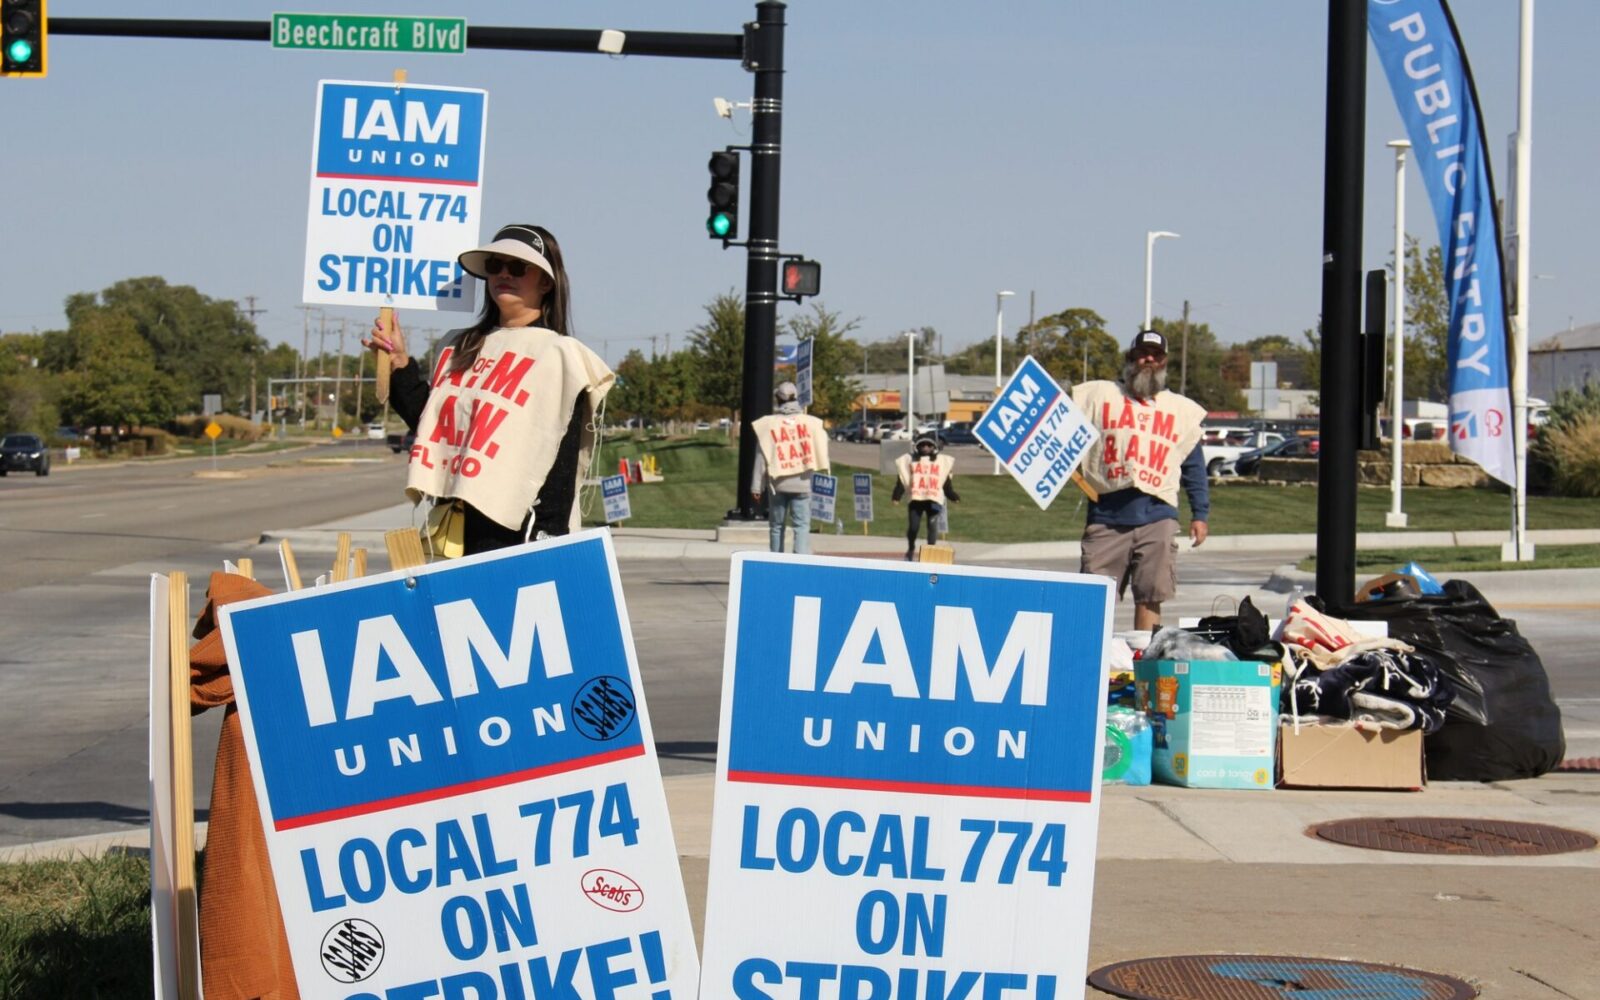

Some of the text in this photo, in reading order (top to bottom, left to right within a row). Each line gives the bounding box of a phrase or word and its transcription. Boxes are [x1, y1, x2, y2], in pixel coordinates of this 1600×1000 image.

[278, 17, 461, 50] Beechcraft Blvd
[341, 97, 461, 146] IAM
[1389, 12, 1467, 197] PUBLIC
[348, 149, 449, 168] UNION
[321, 187, 468, 223] LOCAL 774
[372, 224, 414, 253] ON
[317, 253, 463, 299] STRIKE!
[472, 357, 495, 374] OF
[480, 351, 536, 407] M.
[987, 373, 1041, 441] IAM
[1008, 395, 1047, 446] UNION
[1013, 401, 1070, 475] LOCAL 774
[1035, 424, 1092, 499] STRIKE!
[1043, 435, 1063, 461] ON
[291, 580, 574, 727] IAM
[788, 595, 1053, 706] IAM
[334, 703, 567, 776] UNION
[803, 717, 1026, 759] UNION
[299, 782, 640, 913] LOCAL 774
[740, 805, 1067, 887] LOCAL 774
[592, 876, 632, 906] Scabs
[441, 882, 539, 961] ON
[855, 889, 948, 957] ON
[322, 922, 383, 979] SCABS
